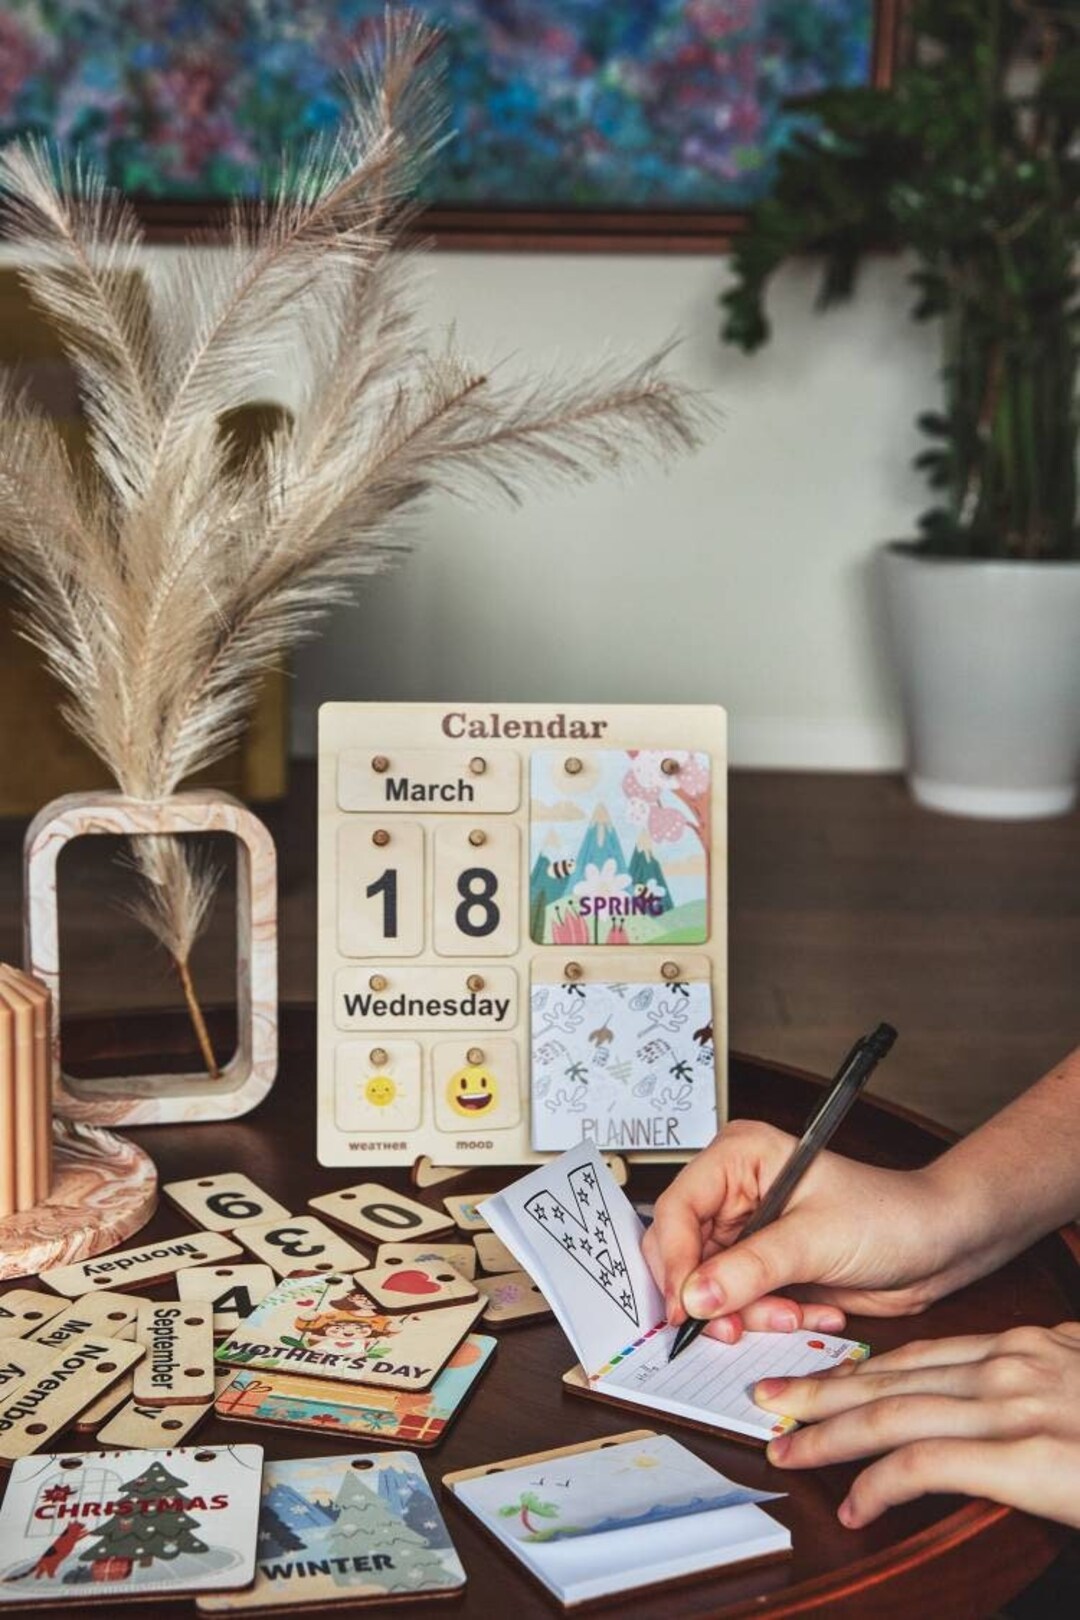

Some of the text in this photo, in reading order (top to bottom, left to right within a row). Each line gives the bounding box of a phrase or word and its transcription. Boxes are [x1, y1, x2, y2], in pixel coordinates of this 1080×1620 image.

[441, 712, 608, 740] Calendar
[385, 778, 475, 802] March
[366, 868, 398, 939] 1
[455, 867, 500, 938] 8
[579, 896, 664, 917] SPRING
[344, 993, 511, 1022] Wednesday
[582, 1117, 680, 1147] PLANNER
[83, 1242, 202, 1277] Monday
[212, 1285, 259, 1319] 4
[36, 1319, 93, 1348] May
[147, 1308, 182, 1391] September
[224, 1339, 432, 1380] MOTHER'S DAY
[0, 1343, 110, 1436] Novembe
[34, 1494, 230, 1520] CHRISTMAS
[259, 1553, 397, 1581] WINTER
